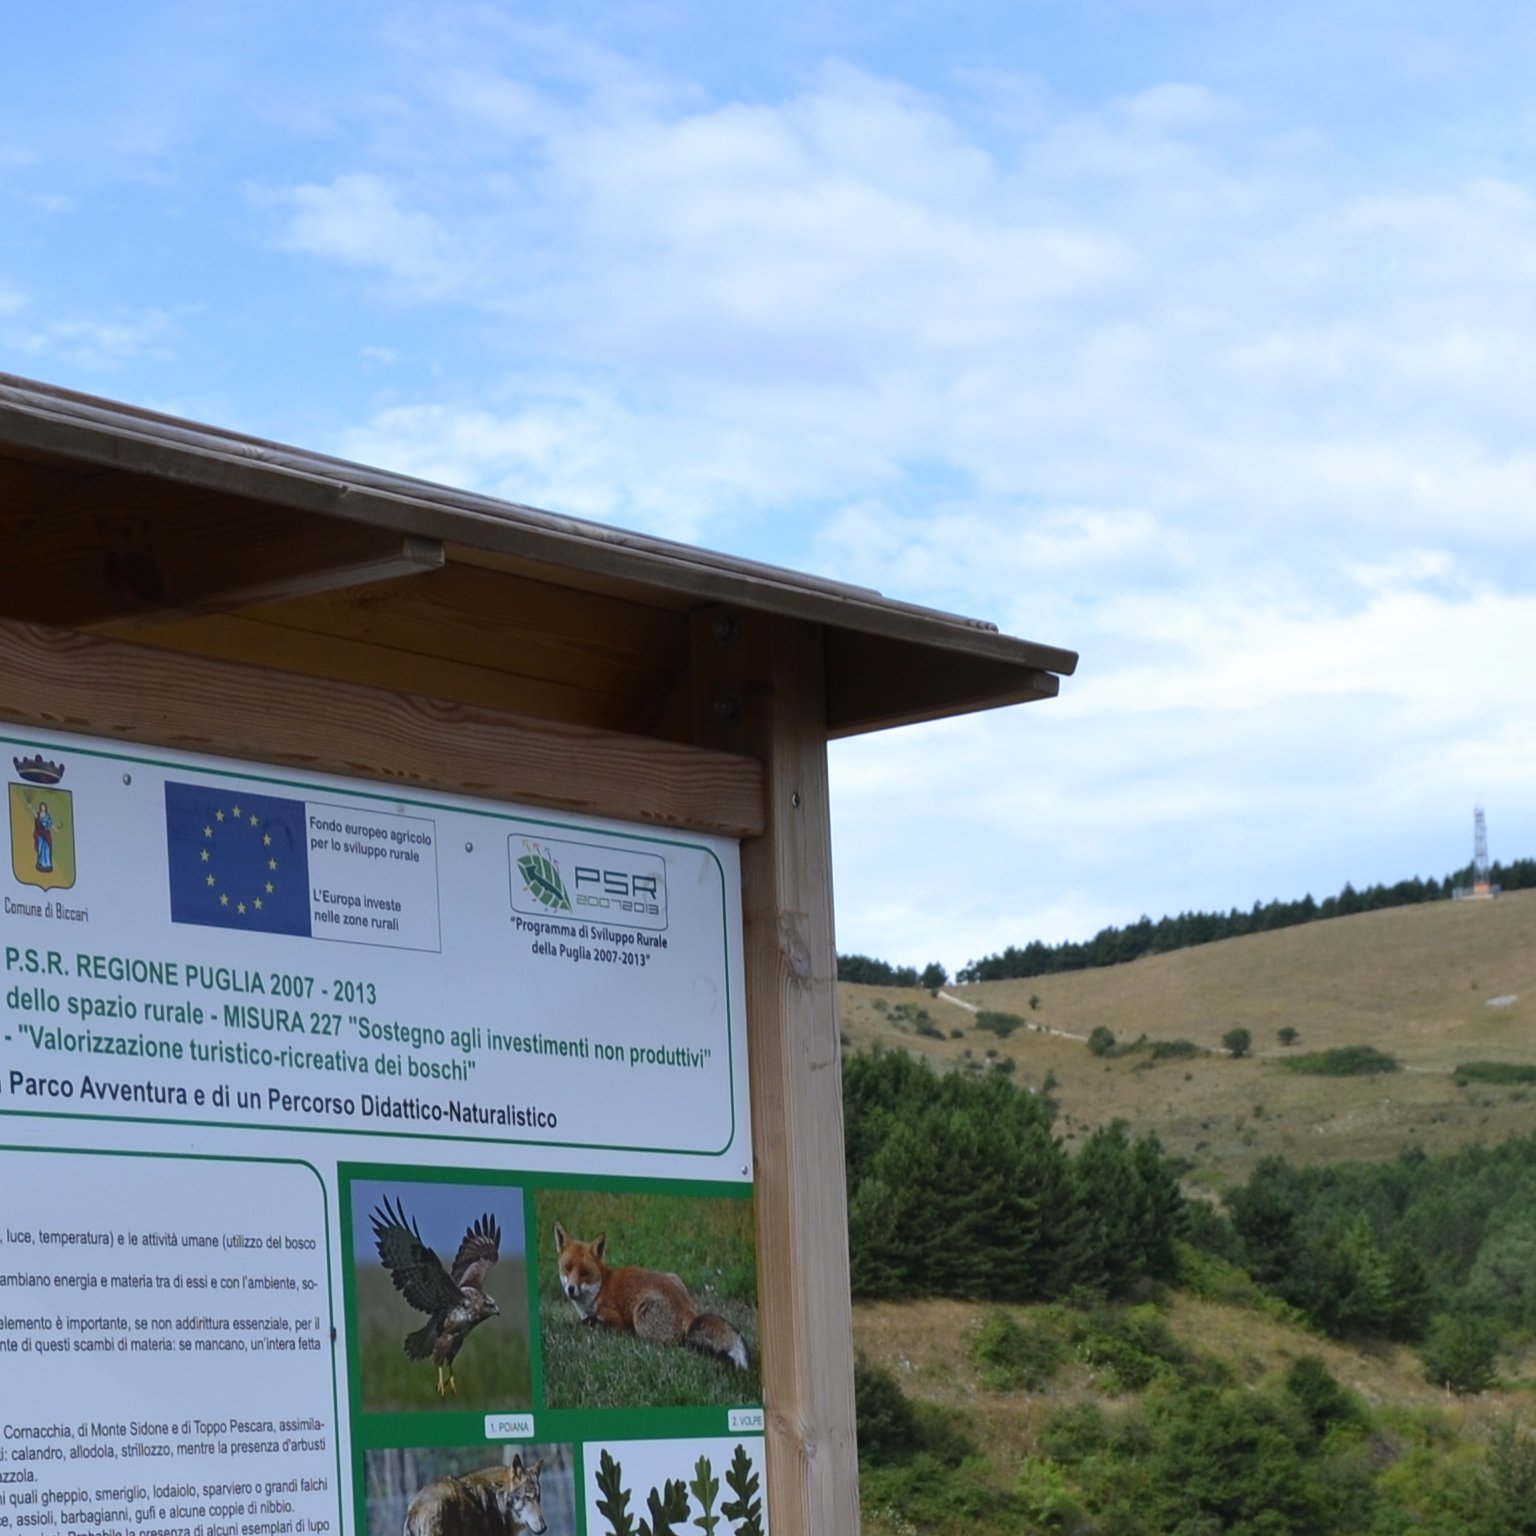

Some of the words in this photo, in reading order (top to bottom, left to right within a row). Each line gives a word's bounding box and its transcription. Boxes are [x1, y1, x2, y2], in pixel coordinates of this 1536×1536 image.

[309, 815, 343, 833] Fondo
[344, 823, 388, 840] europeo
[390, 830, 432, 846] agricolo
[310, 838, 328, 851] per
[330, 837, 341, 852] lo
[343, 841, 387, 860] sviluppo
[389, 848, 420, 863] rurale
[574, 866, 657, 900] PSR
[4, 896, 42, 917] Comune
[44, 901, 53, 918] di
[55, 901, 89, 922] Biccari
[312, 888, 361, 908] L'Europa
[363, 895, 401, 912] investe
[314, 909, 340, 924] nelle
[342, 914, 368, 927] zone
[371, 917, 399, 931] rurali
[510, 916, 576, 937] “Programma
[578, 924, 588, 939] di
[590, 926, 634, 947] Sviluppo
[636, 931, 668, 949] Rurale
[531, 939, 557, 956] della
[559, 943, 591, 962] Puglia
[593, 948, 650, 967] 2007-2013”
[5, 946, 69, 976] P.S.R.
[76, 953, 178, 986] REGIONE
[185, 964, 265, 994] PUGLIA
[270, 973, 314, 998] 2007
[333, 979, 376, 1005] 2013
[6, 985, 60, 1013] dello
[67, 994, 137, 1021] spazio
[144, 1000, 203, 1025] rurale
[223, 1004, 305, 1033] MISURA
[309, 1012, 342, 1036] 227
[348, 1015, 445, 1049] "Sostegno
[450, 1027, 481, 1053] agli
[487, 1028, 589, 1058] investimenti
[594, 1043, 624, 1061] non
[18, 1023, 183, 1059] "Valorizzazione
[189, 1038, 369, 1073] turistico-ricreativa
[374, 1053, 402, 1076] dei
[407, 1055, 476, 1081] boschi"
[9, 1070, 73, 1098] Parco
[79, 1075, 187, 1105] Avventura
[193, 1088, 205, 1106] e
[212, 1084, 230, 1107] di
[236, 1091, 261, 1109] un
[268, 1087, 355, 1115] Percorso
[361, 1094, 557, 1128] Didattico-Naturalistico
[498, 1421, 529, 1433] POIANA
[739, 1415, 762, 1426] VOLPE
